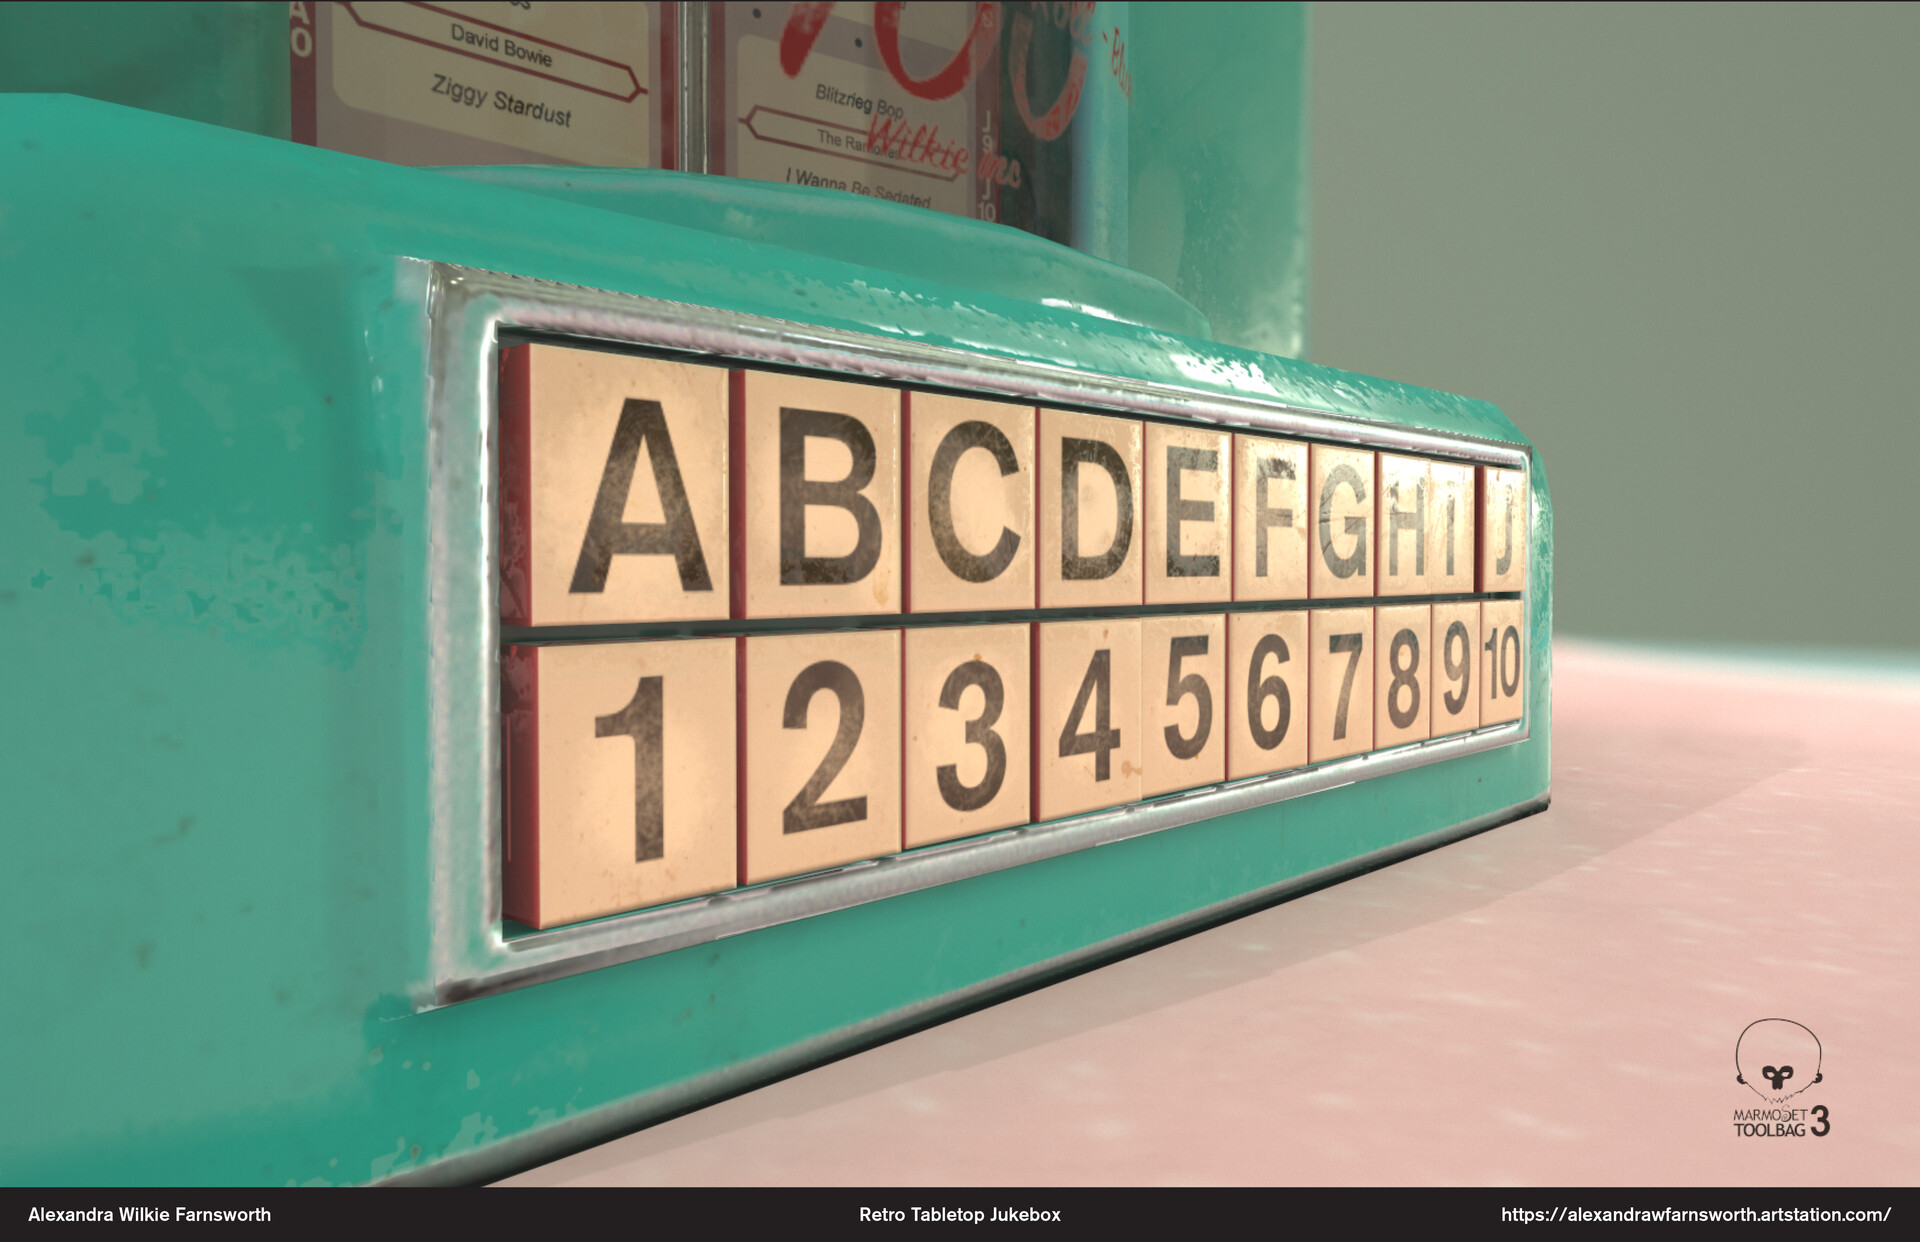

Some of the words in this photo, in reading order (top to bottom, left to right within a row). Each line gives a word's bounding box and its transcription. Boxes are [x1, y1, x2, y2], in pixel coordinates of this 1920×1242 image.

[451, 23, 499, 52] David
[504, 39, 553, 67] Bowie
[431, 73, 488, 109] Ziggy
[493, 90, 572, 128] Stardust
[876, 98, 904, 121] Bop
[817, 128, 842, 146] The
[796, 168, 847, 191] Wanna
[851, 180, 871, 197] Be
[568, 397, 713, 594] A
[779, 406, 883, 586] B
[928, 420, 1022, 583] C
[1061, 436, 1134, 581] D
[1166, 445, 1220, 578] E
[1256, 456, 1297, 577] F
[1319, 463, 1367, 579] G
[1388, 477, 1425, 577] H
[1446, 480, 1456, 576] I
[1496, 483, 1513, 576] J
[595, 675, 664, 863] 1
[783, 660, 868, 835] 2
[936, 660, 1007, 812] 3
[1059, 649, 1121, 782] 4
[1163, 634, 1213, 760] 5
[1247, 634, 1291, 751] 6
[1329, 632, 1363, 741] 7
[1387, 628, 1421, 729] 8
[1444, 620, 1471, 716] 9
[1484, 625, 1521, 700] 10
